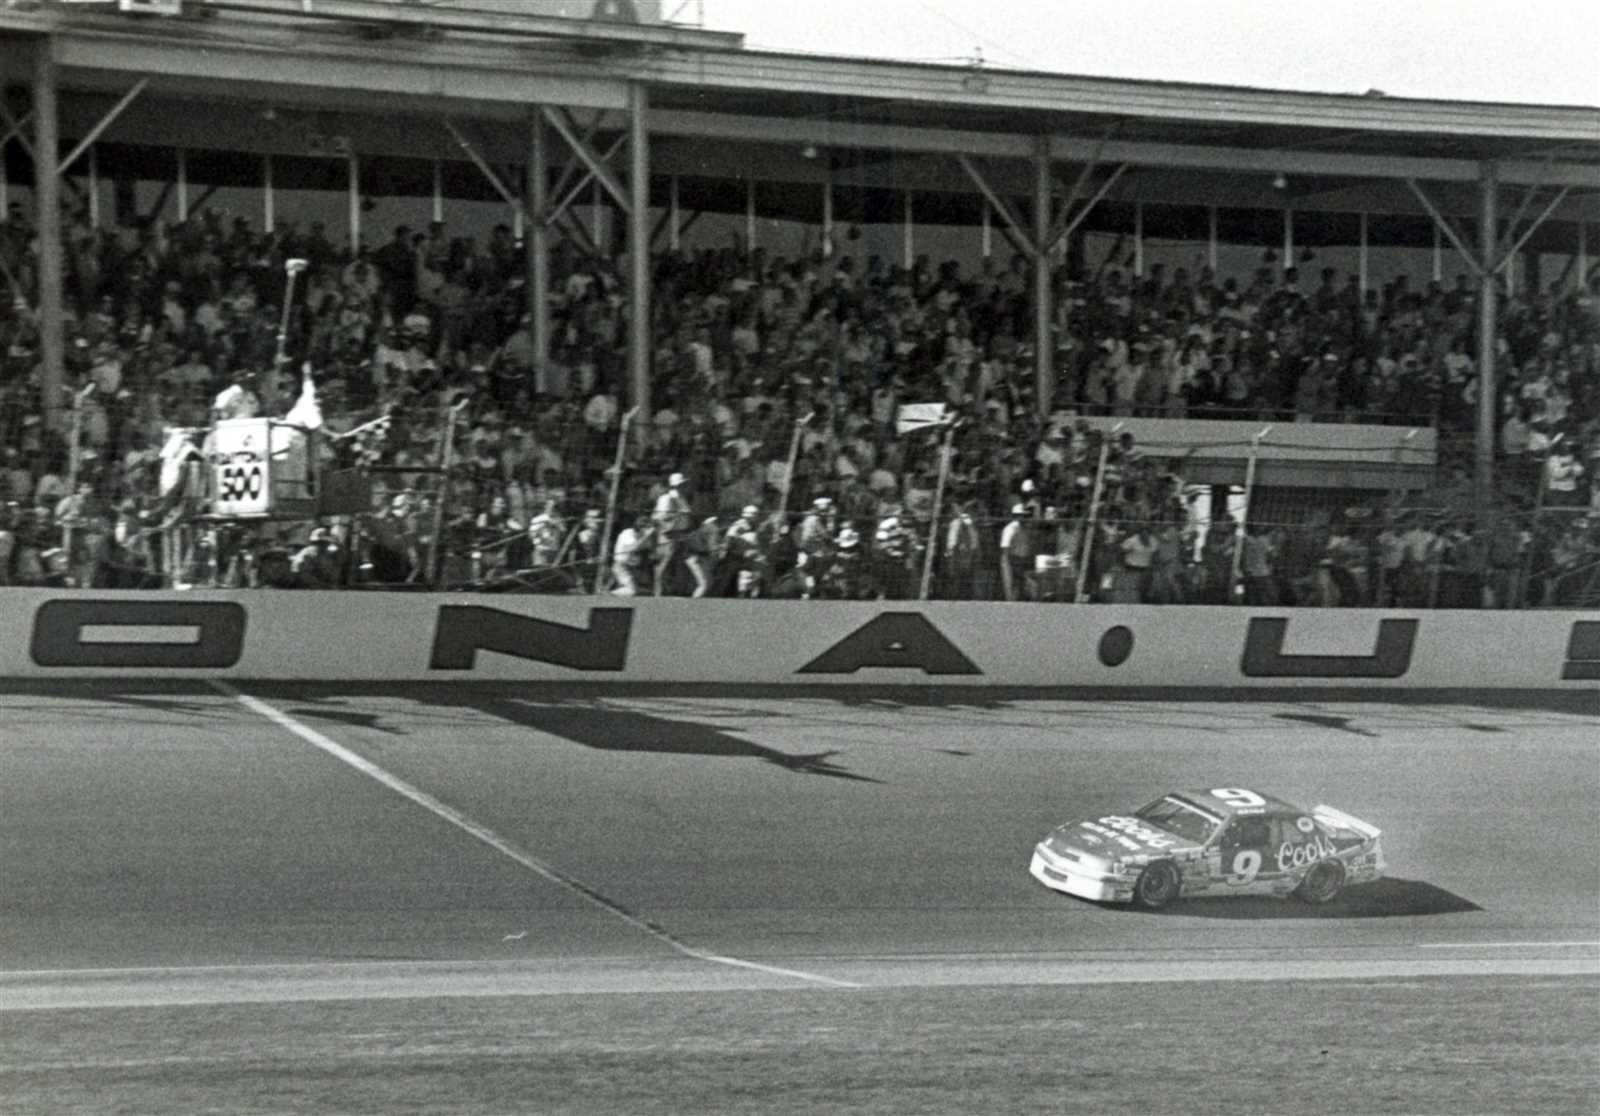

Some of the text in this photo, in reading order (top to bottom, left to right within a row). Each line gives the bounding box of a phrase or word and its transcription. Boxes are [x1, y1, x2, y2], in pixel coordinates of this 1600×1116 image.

[222, 467, 261, 502] 500
[1242, 617, 1600, 681] U
[1211, 788, 1266, 806] 9
[1227, 850, 1262, 885] 9
